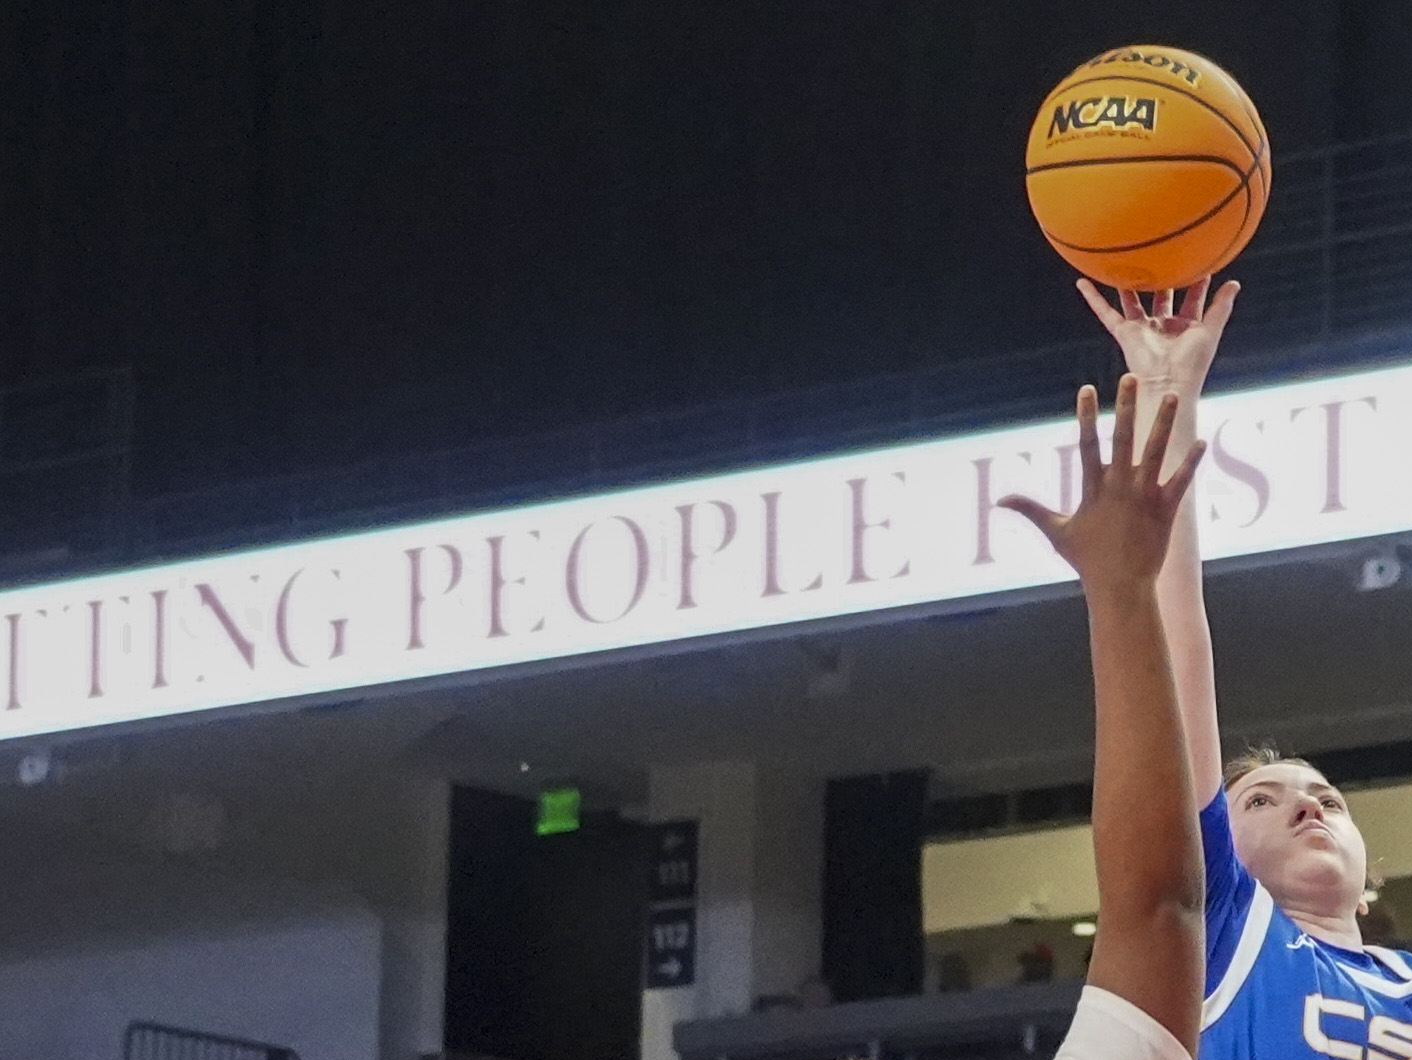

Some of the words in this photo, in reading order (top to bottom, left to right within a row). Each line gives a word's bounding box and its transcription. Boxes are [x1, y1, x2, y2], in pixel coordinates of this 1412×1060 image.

[1048, 96, 1156, 139] NCAA
[403, 472, 912, 651] PEOPLE
[970, 395, 1378, 566] FIST
